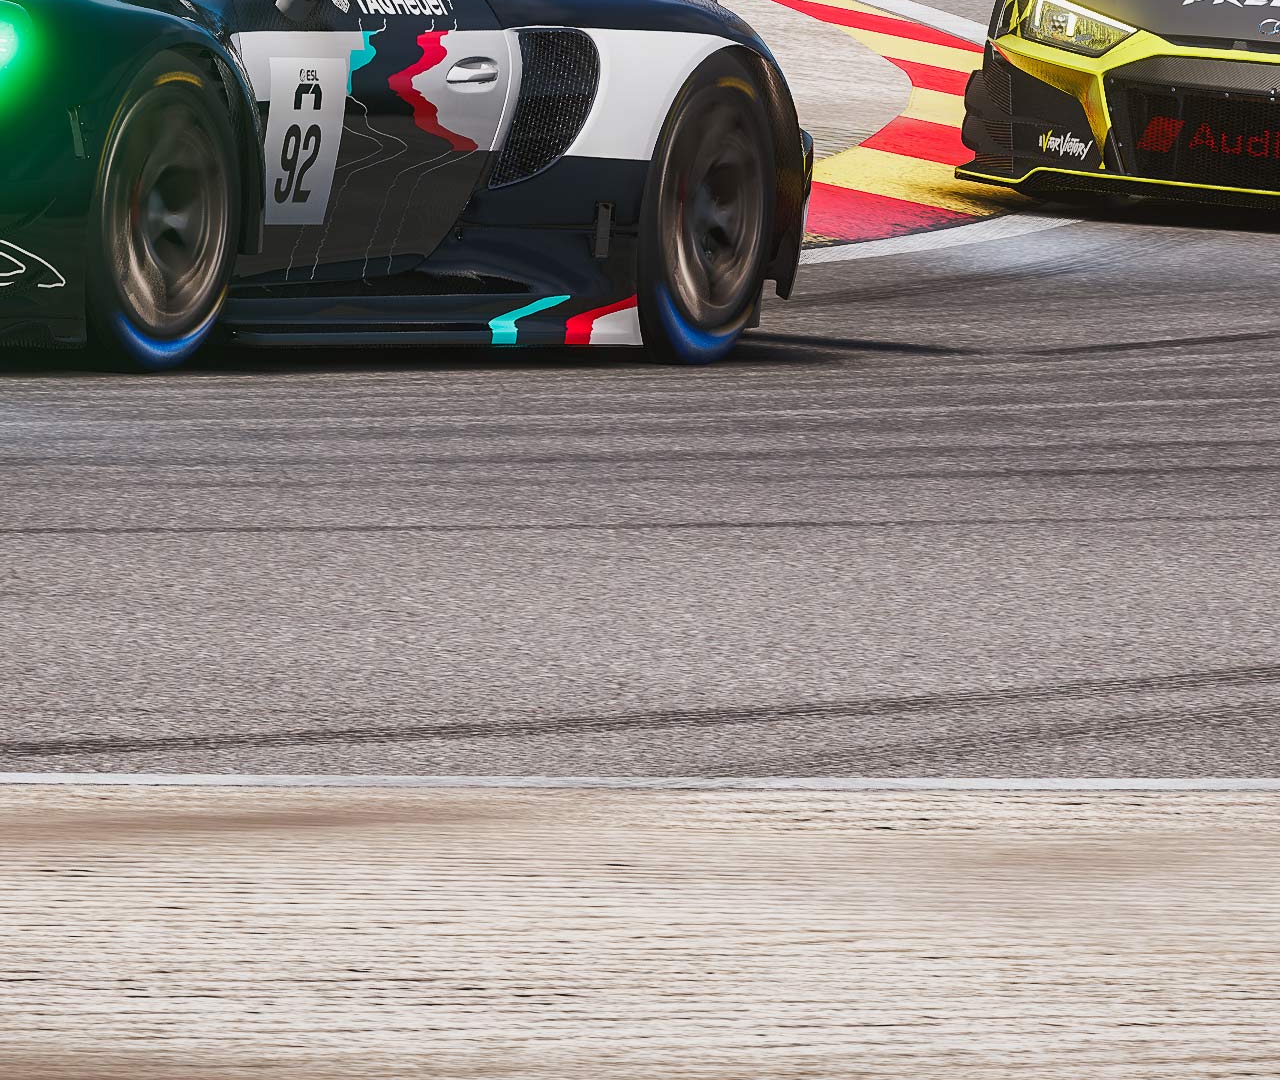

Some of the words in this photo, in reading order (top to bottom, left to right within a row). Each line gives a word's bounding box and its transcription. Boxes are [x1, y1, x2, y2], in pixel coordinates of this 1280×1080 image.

[306, 69, 320, 82] ESL
[1188, 122, 1280, 160] Audi
[274, 123, 322, 204] 92
